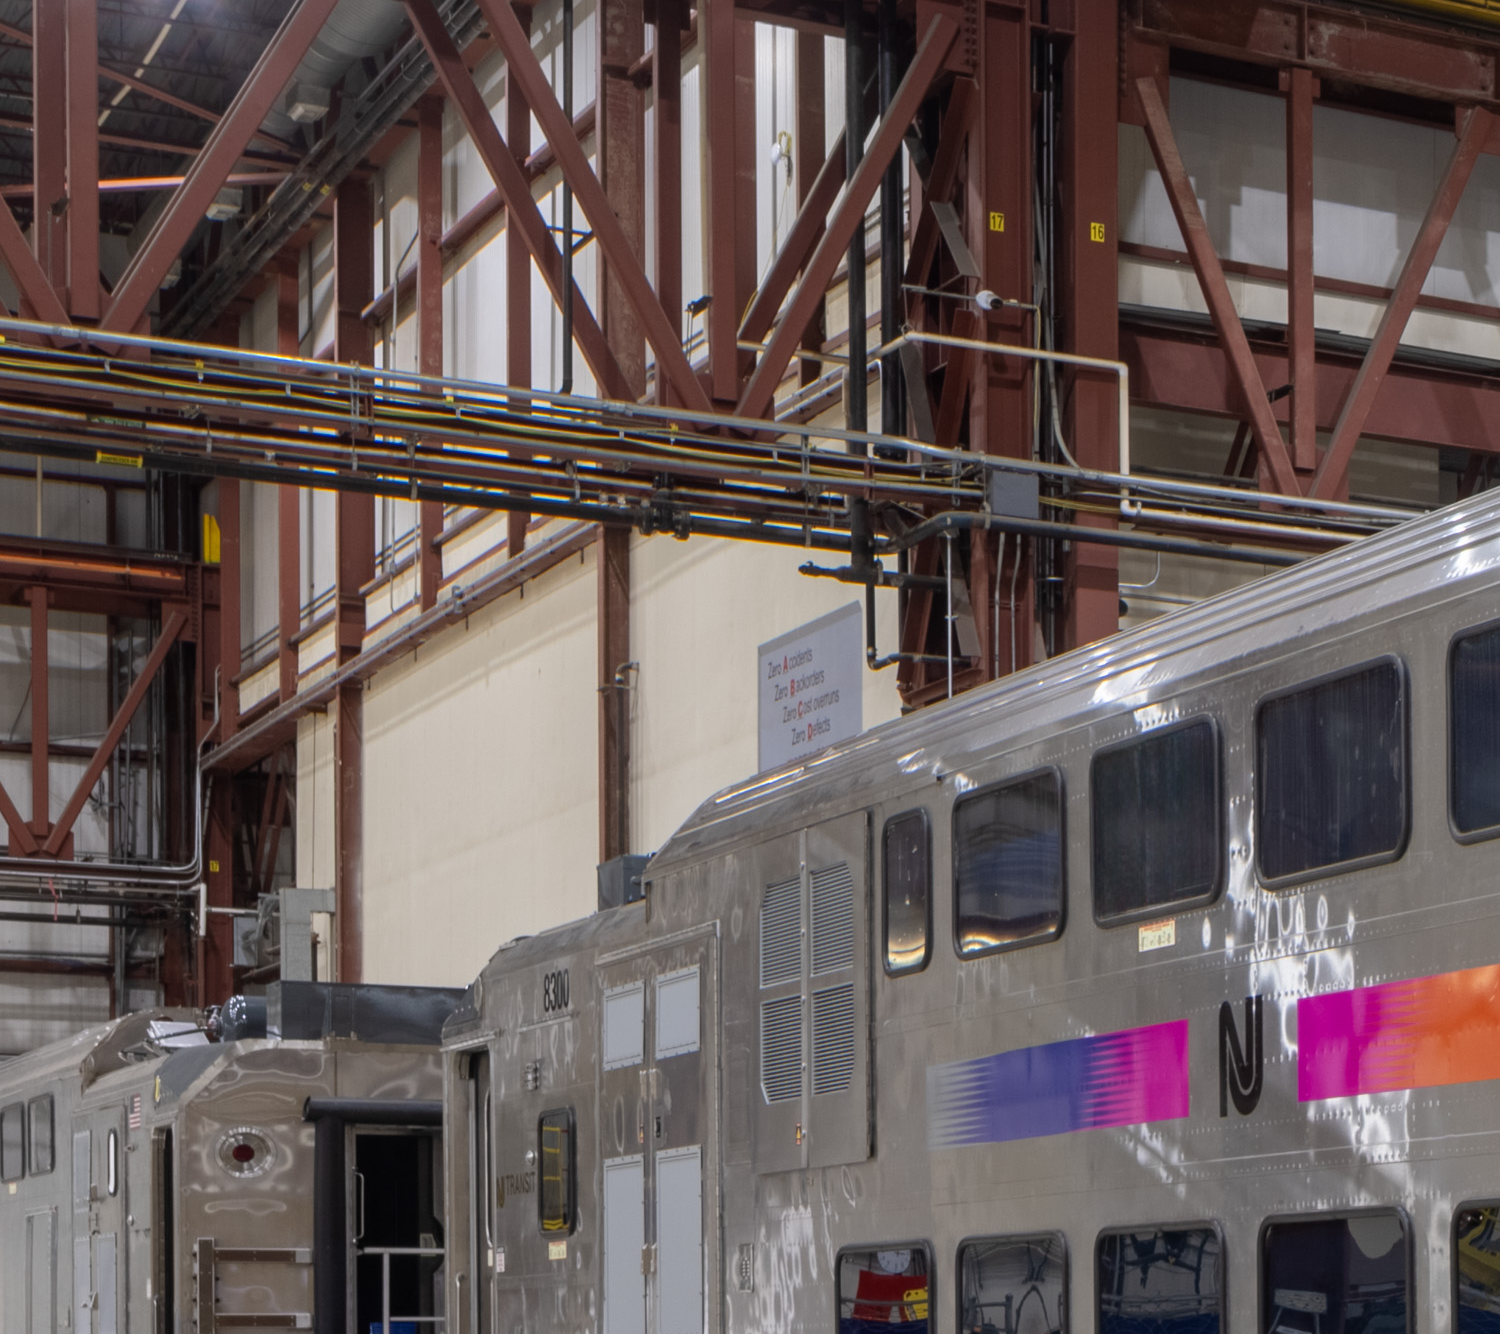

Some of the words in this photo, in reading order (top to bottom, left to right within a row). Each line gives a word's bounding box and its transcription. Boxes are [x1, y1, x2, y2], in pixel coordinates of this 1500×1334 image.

[991, 214, 1004, 230] 17
[1092, 224, 1104, 240] 16
[768, 662, 782, 680] Zero
[782, 648, 813, 672] Accidents
[774, 684, 788, 702] Zero
[790, 670, 825, 697] Backorders
[783, 706, 797, 724] Zero
[797, 700, 814, 719] Cost
[814, 689, 840, 710] overruns
[792, 728, 806, 746] Zero
[807, 718, 831, 742] Defects
[544, 968, 570, 1012] 8300
[1218, 995, 1264, 1118] NJ
[506, 1172, 536, 1196] TRANSIT
